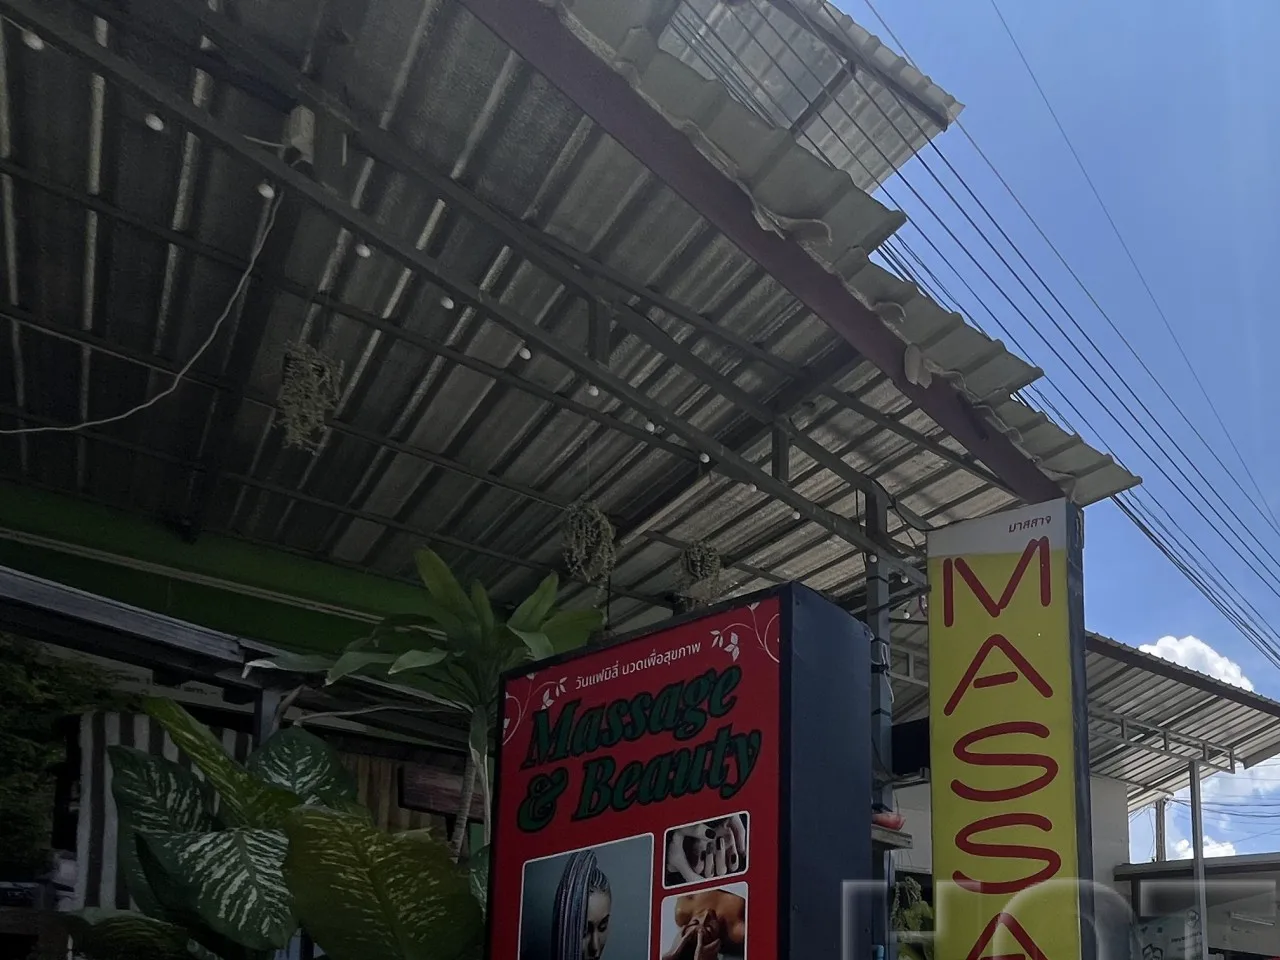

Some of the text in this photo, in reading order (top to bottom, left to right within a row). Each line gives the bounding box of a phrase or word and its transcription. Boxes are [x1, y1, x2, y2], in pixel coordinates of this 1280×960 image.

[622, 642, 701, 675] นวดเพื่อสุขภาพ
[520, 665, 742, 771] Massage
[517, 724, 762, 833] & Beauty
